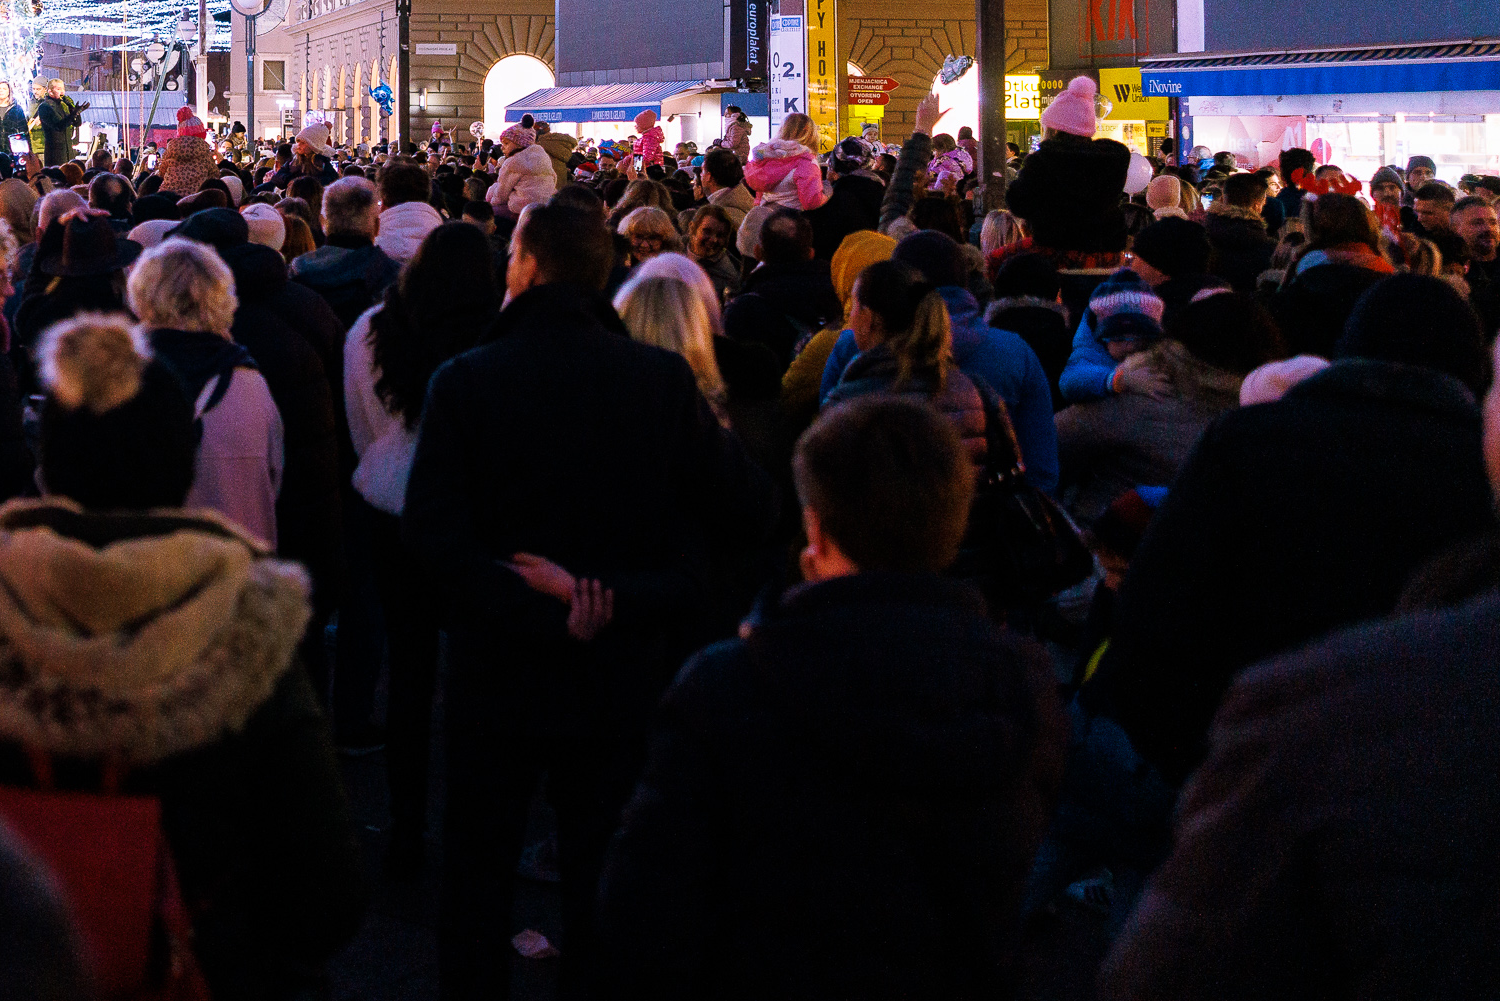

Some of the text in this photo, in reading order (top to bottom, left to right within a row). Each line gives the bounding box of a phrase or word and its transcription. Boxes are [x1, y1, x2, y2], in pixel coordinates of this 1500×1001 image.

[749, 3, 758, 65] europlakat
[782, 62, 801, 78] 2.
[1150, 80, 1182, 94] iNovine
